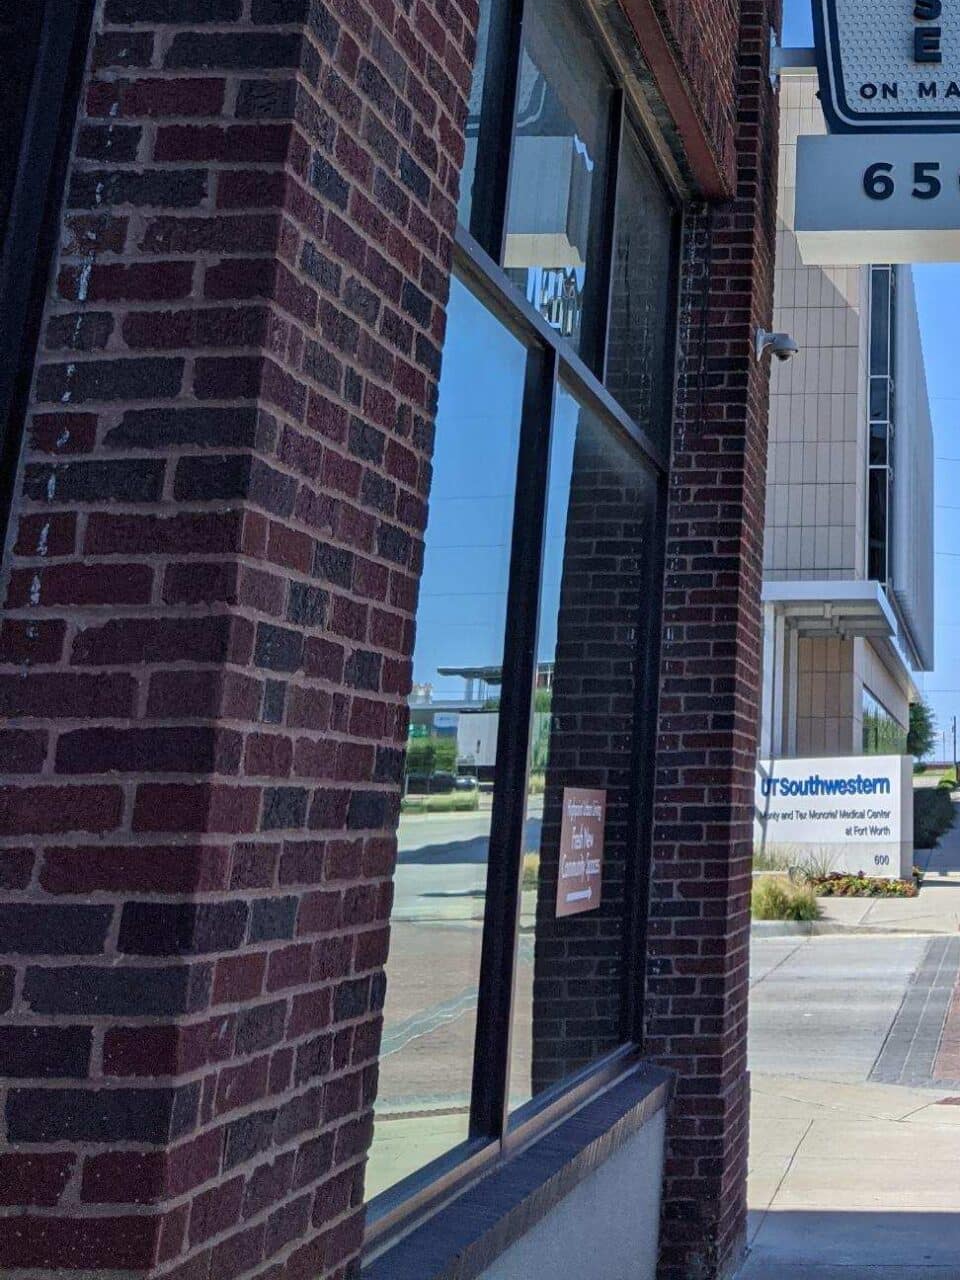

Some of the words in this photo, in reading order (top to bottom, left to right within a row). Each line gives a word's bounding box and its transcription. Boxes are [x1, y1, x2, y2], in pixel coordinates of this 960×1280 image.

[860, 82, 898, 100] ON
[866, 808, 891, 819] Center
[853, 824, 868, 836] Fort
[868, 823, 891, 836] Worth
[874, 854, 890, 866] 600
